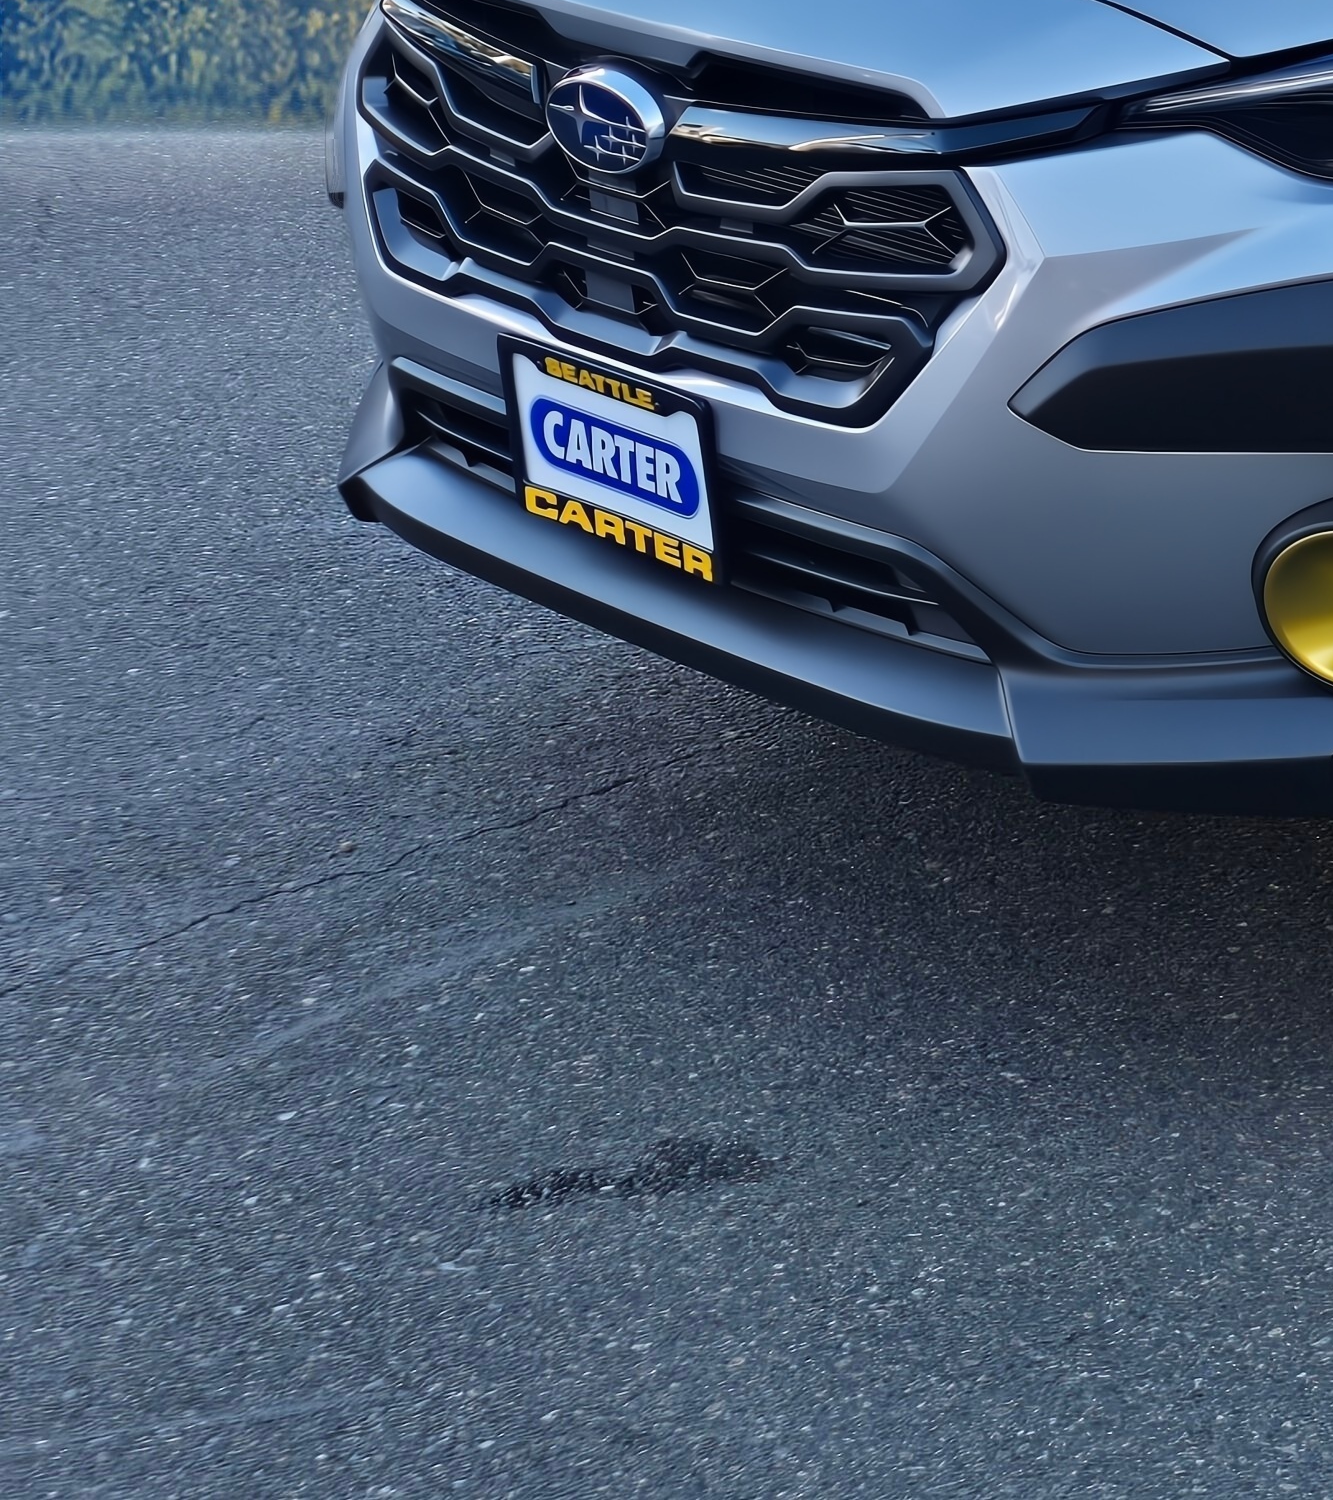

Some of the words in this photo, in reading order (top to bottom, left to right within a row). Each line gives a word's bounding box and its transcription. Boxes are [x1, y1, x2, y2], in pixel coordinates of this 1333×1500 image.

[543, 356, 656, 411] SEATTLE
[542, 408, 683, 504] CARTER
[523, 485, 714, 583] CARTER
